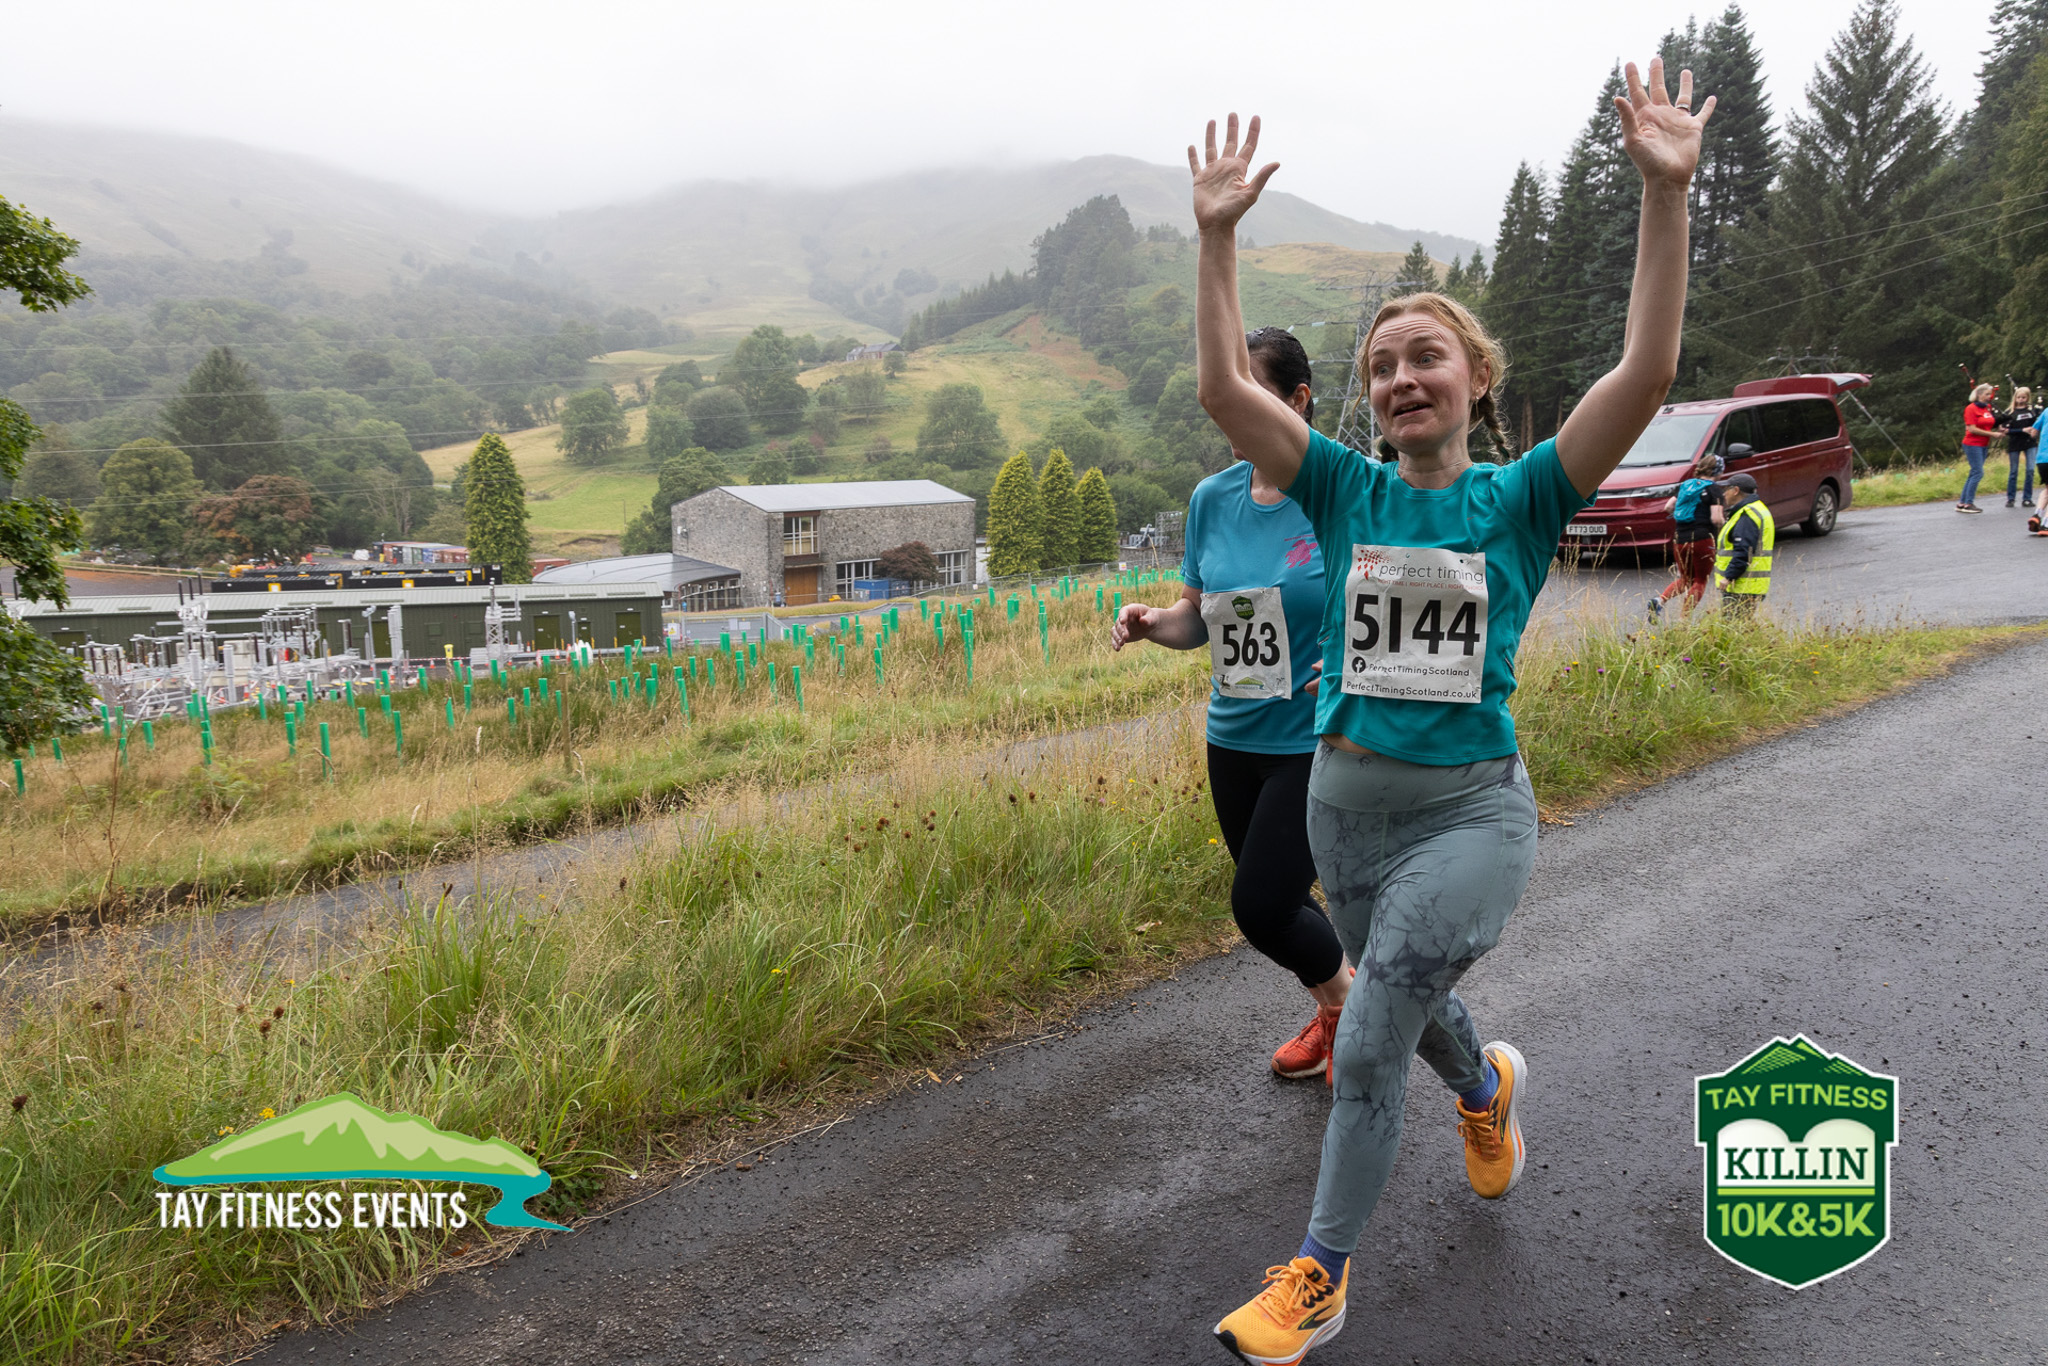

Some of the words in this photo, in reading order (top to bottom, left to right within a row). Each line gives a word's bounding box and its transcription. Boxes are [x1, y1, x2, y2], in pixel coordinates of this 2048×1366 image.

[1379, 563, 1432, 578] perfect
[1437, 566, 1484, 584] timing
[1352, 593, 1480, 656] 5144
[1223, 622, 1281, 667] 563
[1346, 681, 1477, 699] PerfectTimingScotland.co.uk
